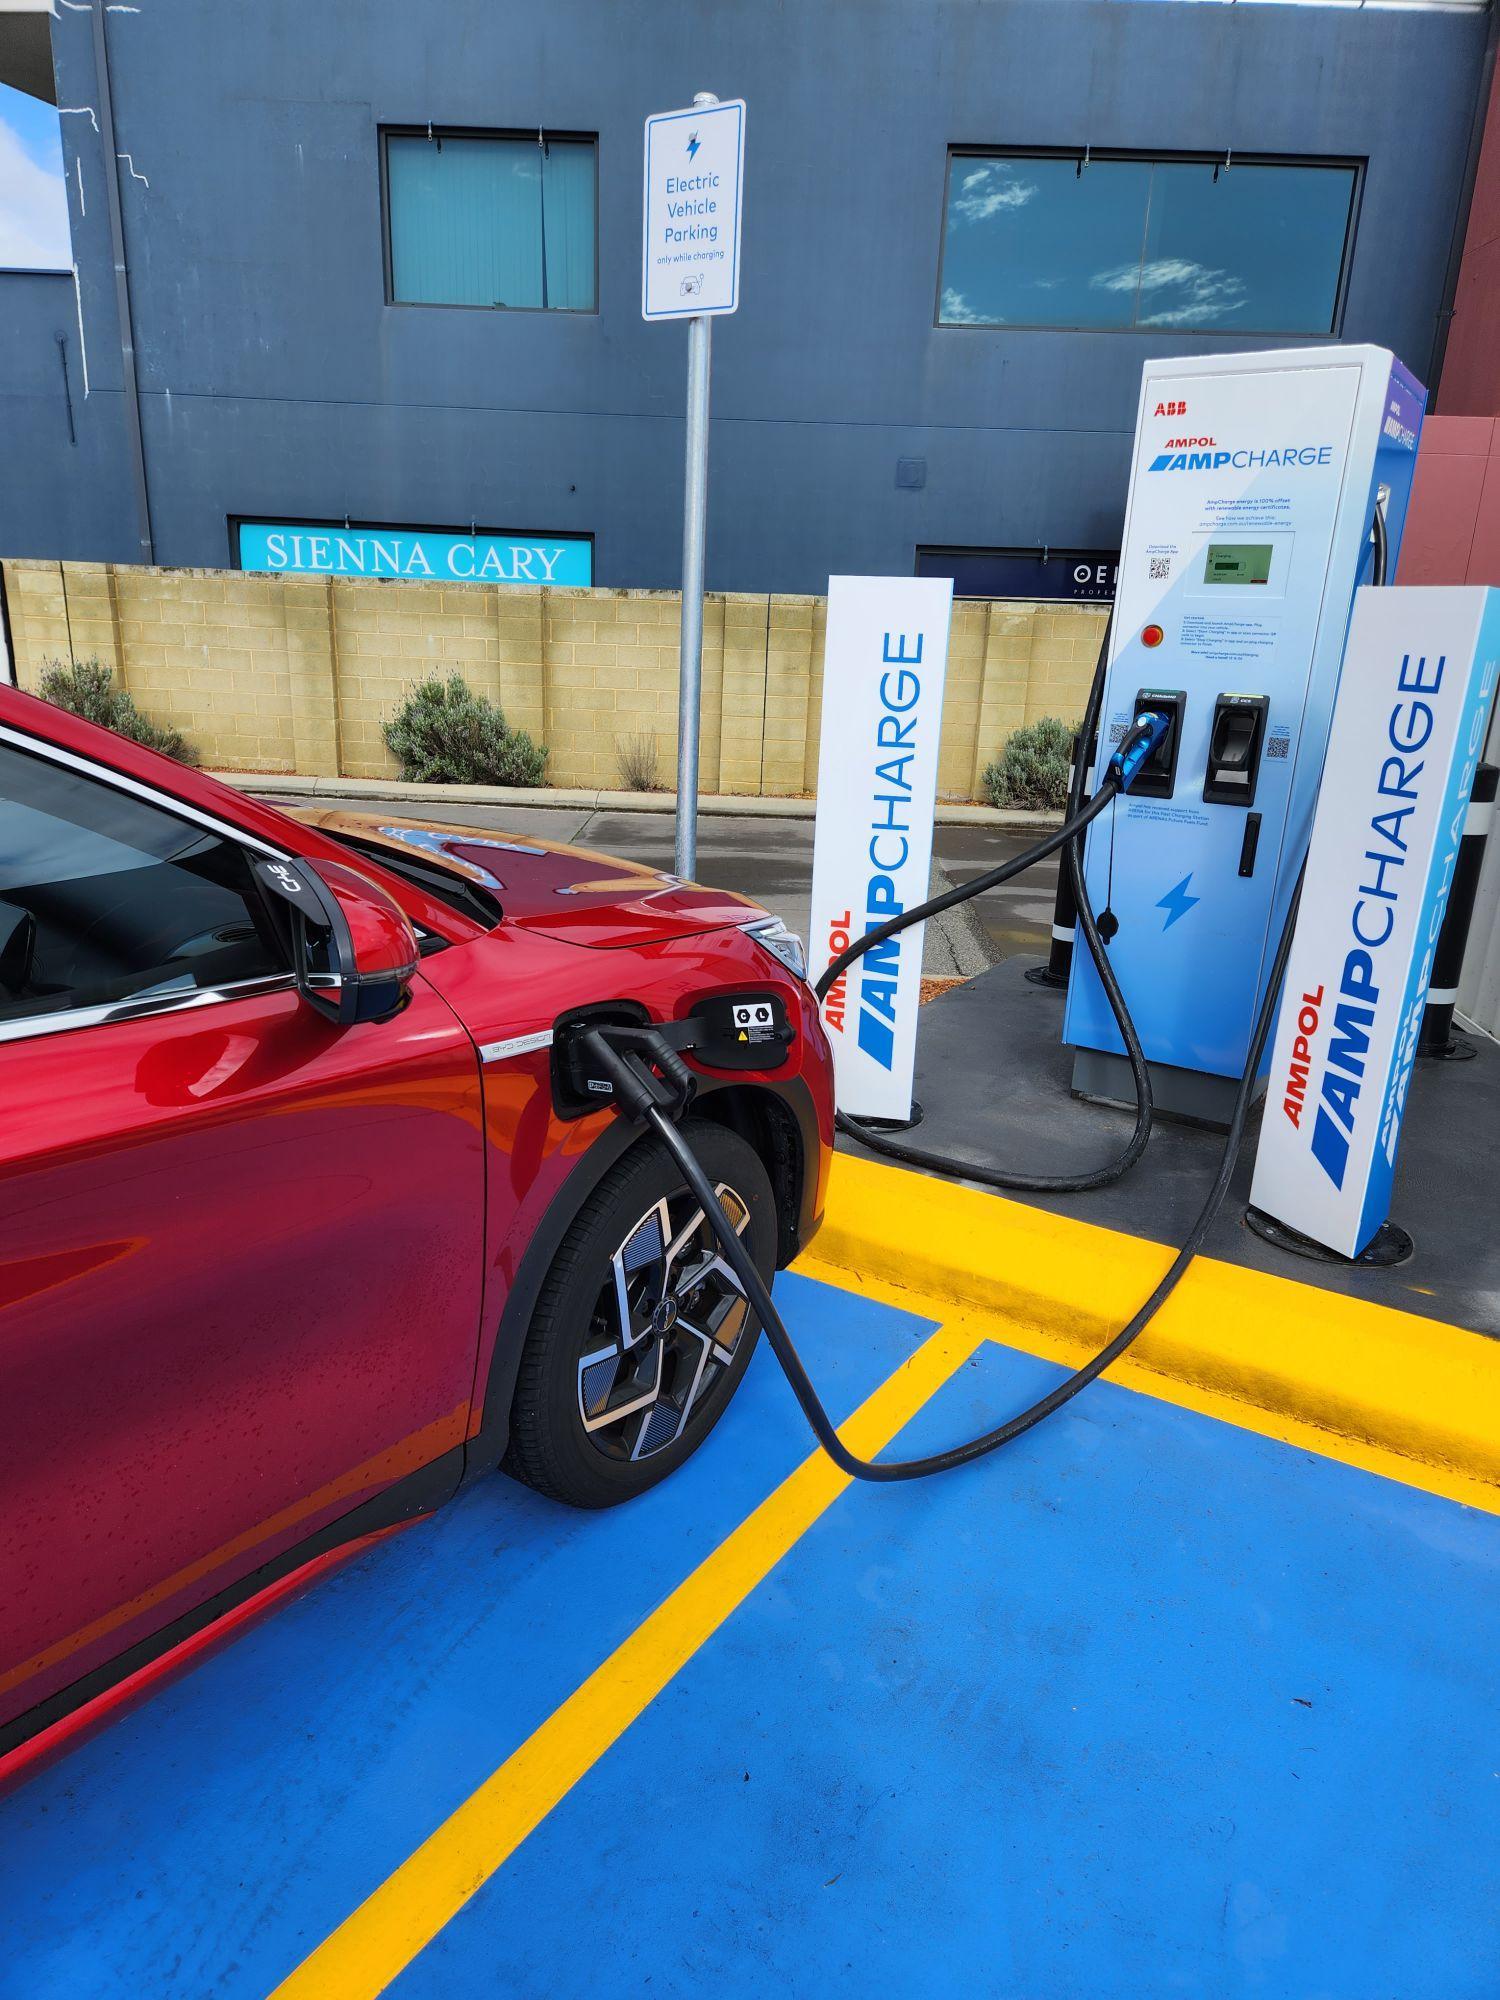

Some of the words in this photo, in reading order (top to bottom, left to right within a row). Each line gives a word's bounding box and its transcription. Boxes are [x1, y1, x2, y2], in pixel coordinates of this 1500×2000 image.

[666, 172, 719, 194] Electric
[667, 198, 717, 218] Vehicle
[665, 225, 718, 243] Parking
[657, 255, 671, 264] only
[673, 254, 692, 263] while
[693, 250, 724, 261] charging
[1153, 400, 1187, 417] ABB
[1164, 437, 1217, 449] AMPOL
[1168, 447, 1333, 471] AMPCHARGE
[266, 534, 435, 575] SIENNA
[447, 543, 566, 581] CARY
[860, 632, 924, 1023] AMPCHARGE
[267, 864, 301, 892] BYD
[1397, 660, 1496, 1113] AMPCHARGE
[1320, 655, 1446, 1134] AMPCHARGE
[492, 1044, 514, 1054] BYD
[516, 1034, 550, 1048] DESIGN
[1282, 985, 1324, 1130] AMPOL
